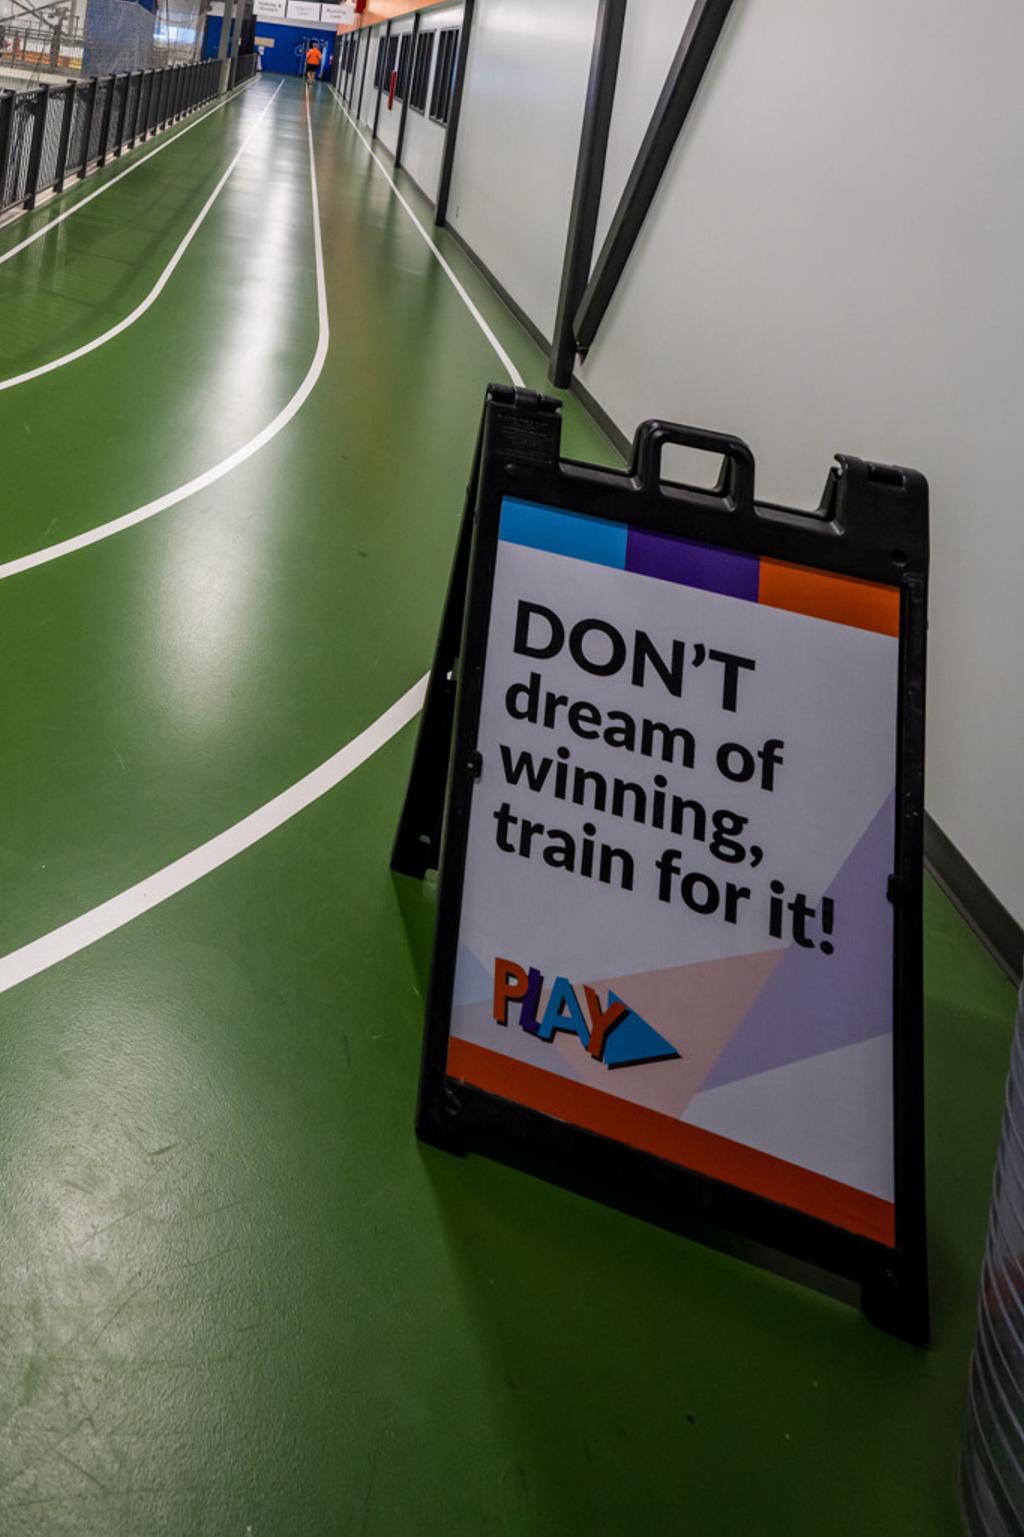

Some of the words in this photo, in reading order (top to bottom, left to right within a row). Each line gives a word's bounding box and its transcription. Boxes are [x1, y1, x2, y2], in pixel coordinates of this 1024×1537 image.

[513, 600, 756, 712] DON’T
[505, 672, 695, 768] dream
[716, 740, 784, 792] of
[499, 745, 764, 867] winning,
[493, 803, 634, 891] train
[656, 849, 751, 925] for
[769, 879, 835, 955] it!
[492, 957, 632, 1064] PLAY
